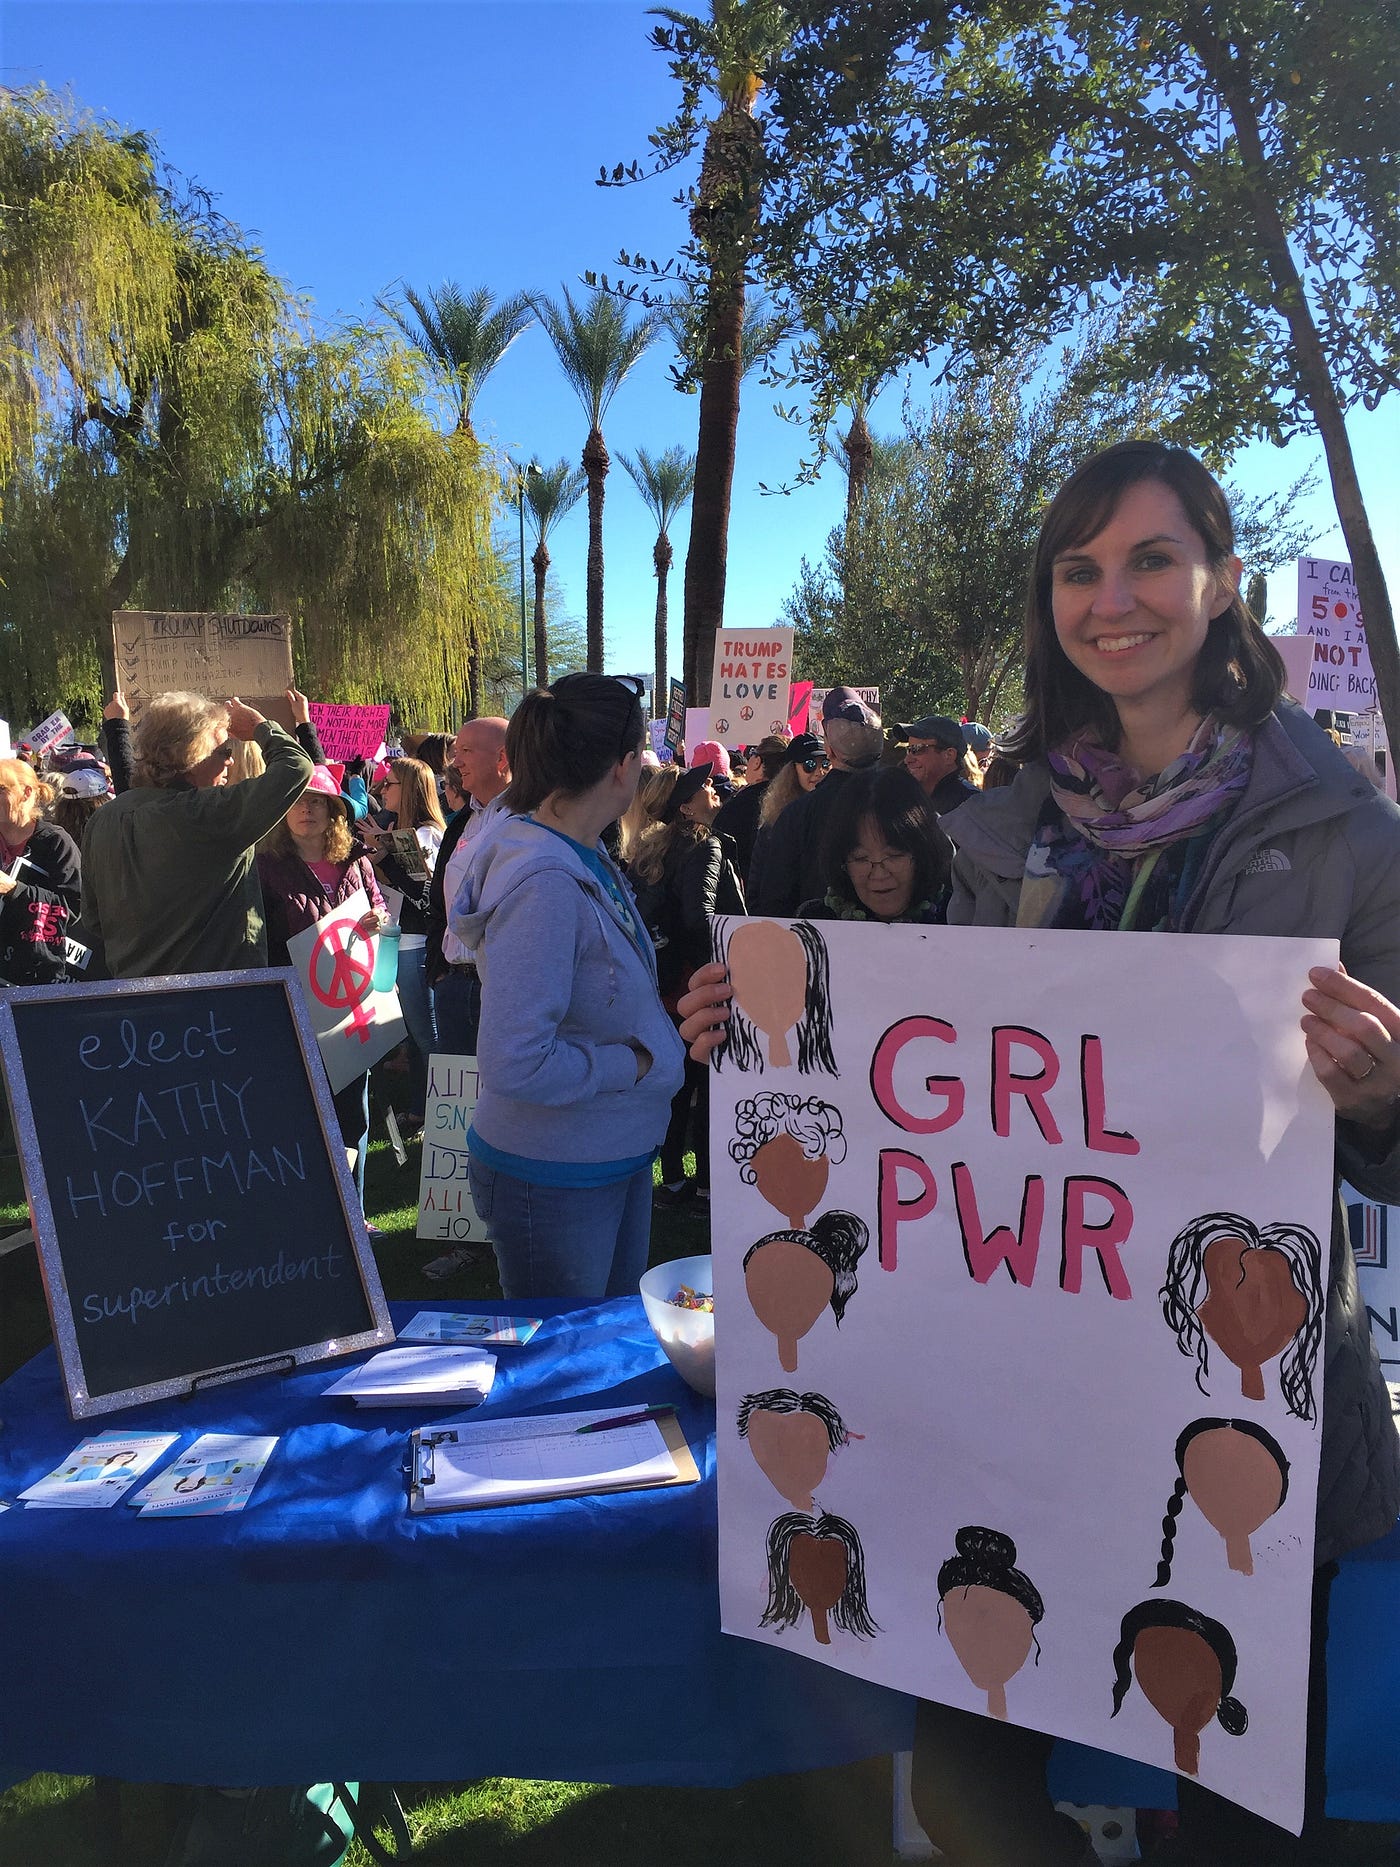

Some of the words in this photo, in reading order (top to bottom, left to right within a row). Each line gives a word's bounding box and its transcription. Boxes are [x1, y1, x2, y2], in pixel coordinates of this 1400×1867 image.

[1306, 560, 1318, 579] I
[1323, 582, 1341, 597] from
[146, 616, 206, 635] TRUMP
[1307, 625, 1331, 637] AND
[1344, 630, 1351, 641] I
[1357, 633, 1367, 644] A
[723, 641, 783, 657] TRUMP
[1315, 642, 1362, 667] NOT
[720, 662, 787, 679] HATES
[723, 683, 778, 699] LOVE
[1308, 672, 1340, 692] OING
[1348, 674, 1377, 696] BACK
[327, 706, 351, 717] THEIR
[51, 723, 63, 734] THE
[326, 718, 363, 729] NOTHING
[366, 719, 385, 730] MORE
[32, 726, 50, 742] GRAB
[79, 1011, 237, 1071] elect
[869, 1014, 1140, 1155] GRL
[79, 1077, 254, 1151] KATHY
[66, 1143, 306, 1218] HOFFMAN
[437, 1217, 471, 1240] OF
[877, 1148, 1134, 1300] PWR
[162, 1217, 227, 1252] for
